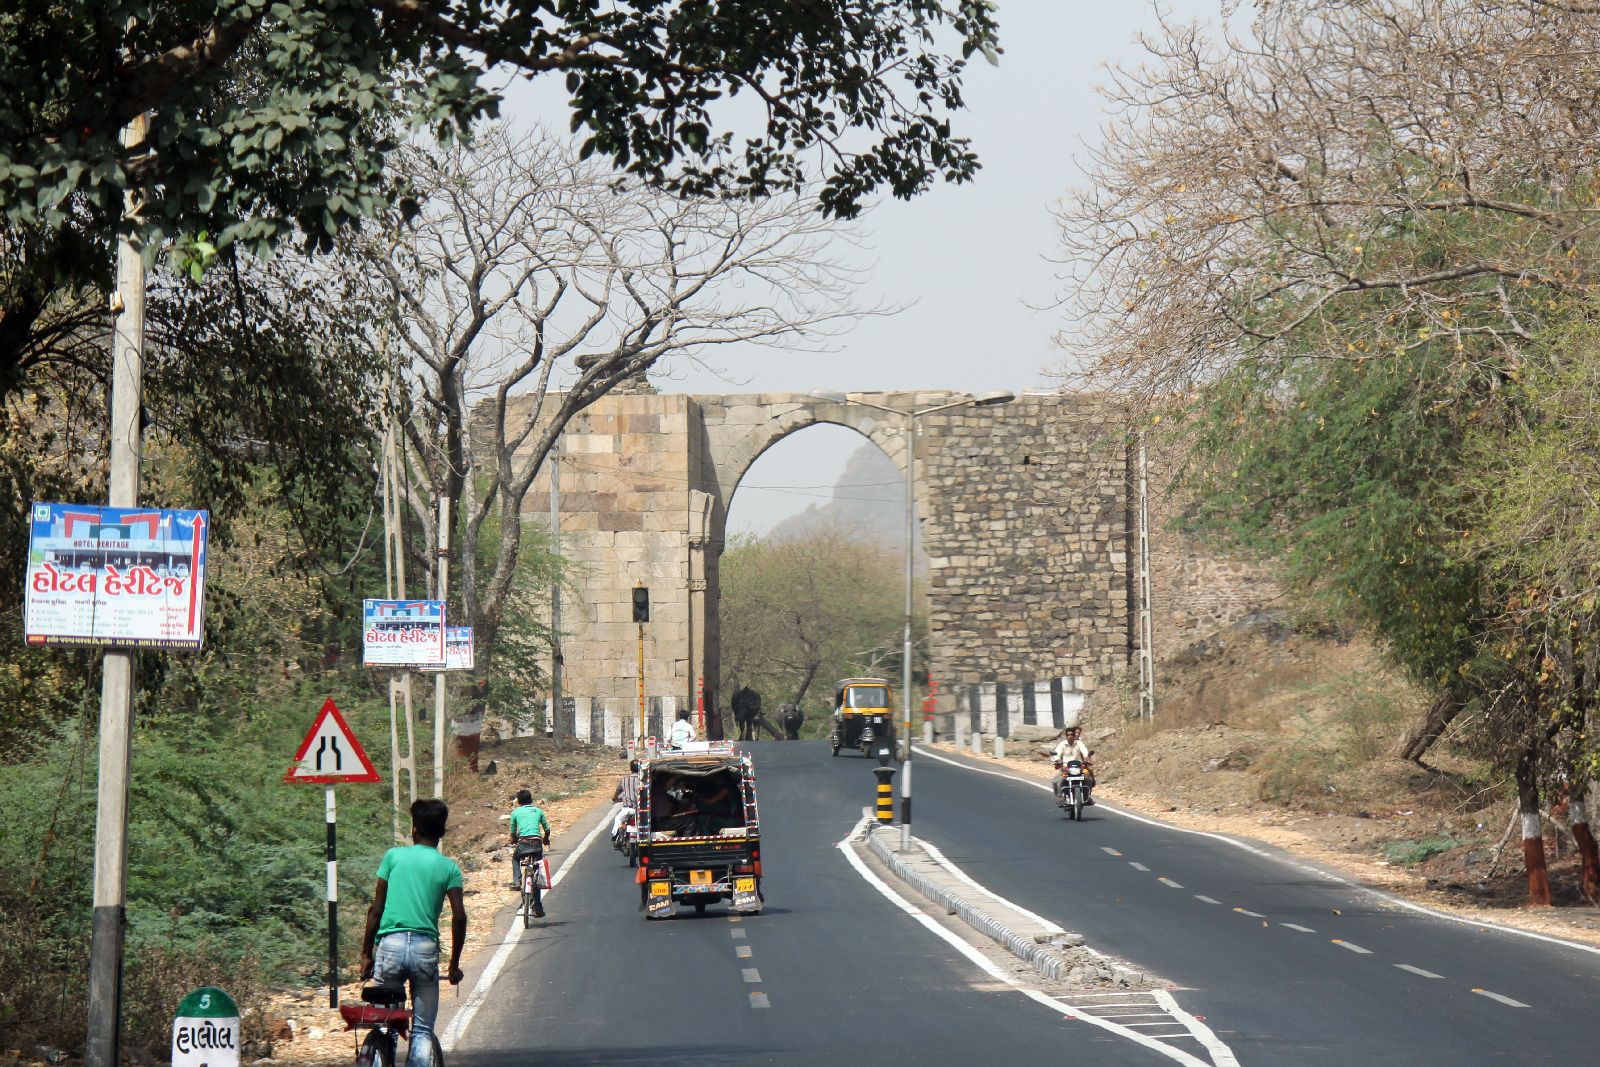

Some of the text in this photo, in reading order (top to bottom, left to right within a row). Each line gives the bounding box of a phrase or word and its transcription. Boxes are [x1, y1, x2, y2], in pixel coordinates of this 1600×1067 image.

[73, 540, 94, 548] HOTEL
[32, 562, 187, 597] હોટલ હેરીટેજ
[366, 627, 438, 643] હોટલ હેરીટેજ
[199, 993, 211, 1009] 5
[176, 1020, 235, 1054] હાલોલ
